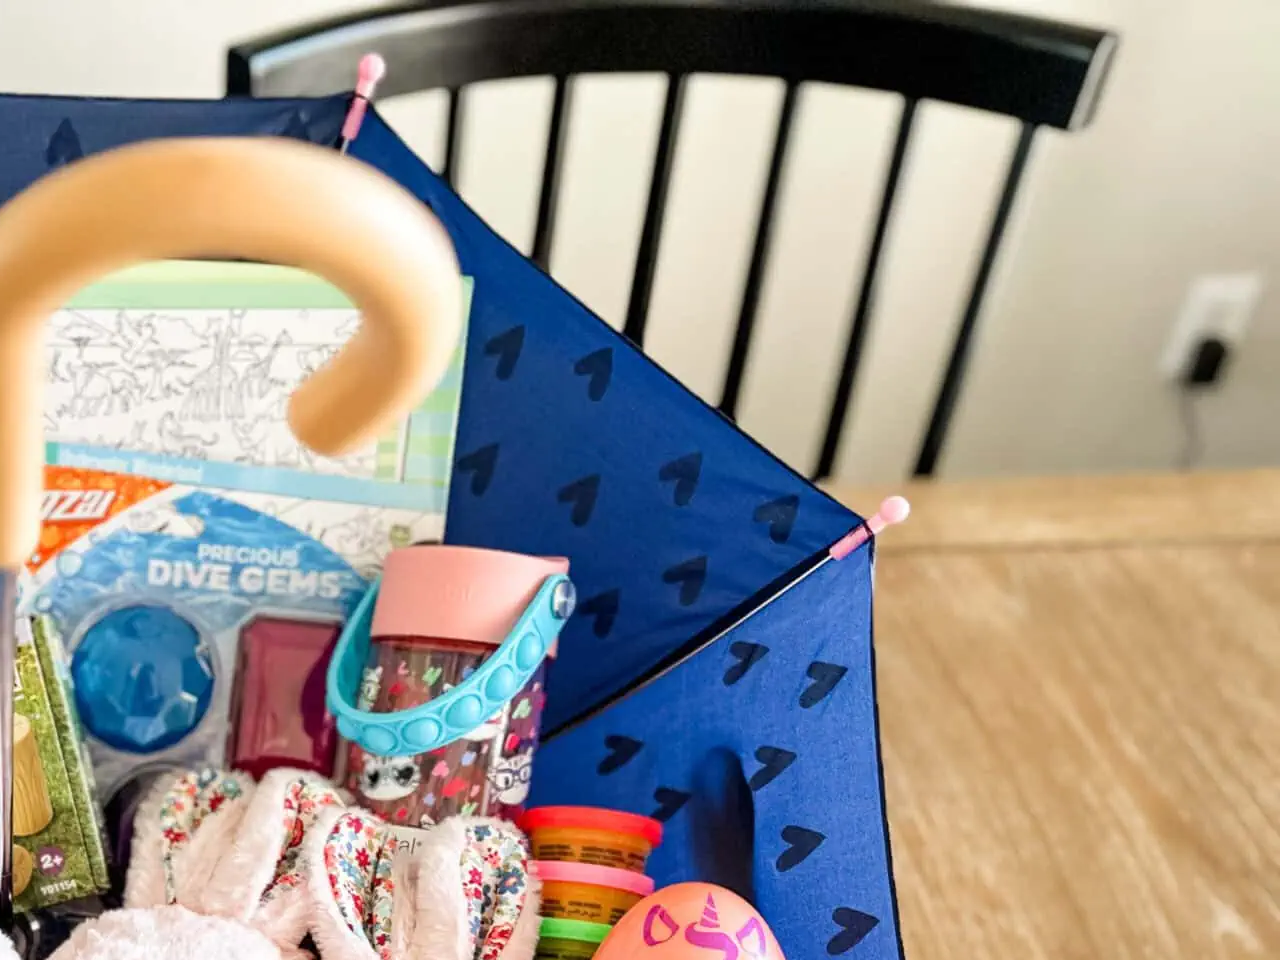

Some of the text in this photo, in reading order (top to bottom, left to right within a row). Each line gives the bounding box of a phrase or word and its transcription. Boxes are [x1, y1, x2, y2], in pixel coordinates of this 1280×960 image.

[196, 543, 299, 567] PRECIOUS
[147, 558, 341, 598] DIVE GEMS
[40, 854, 64, 869] 2+
